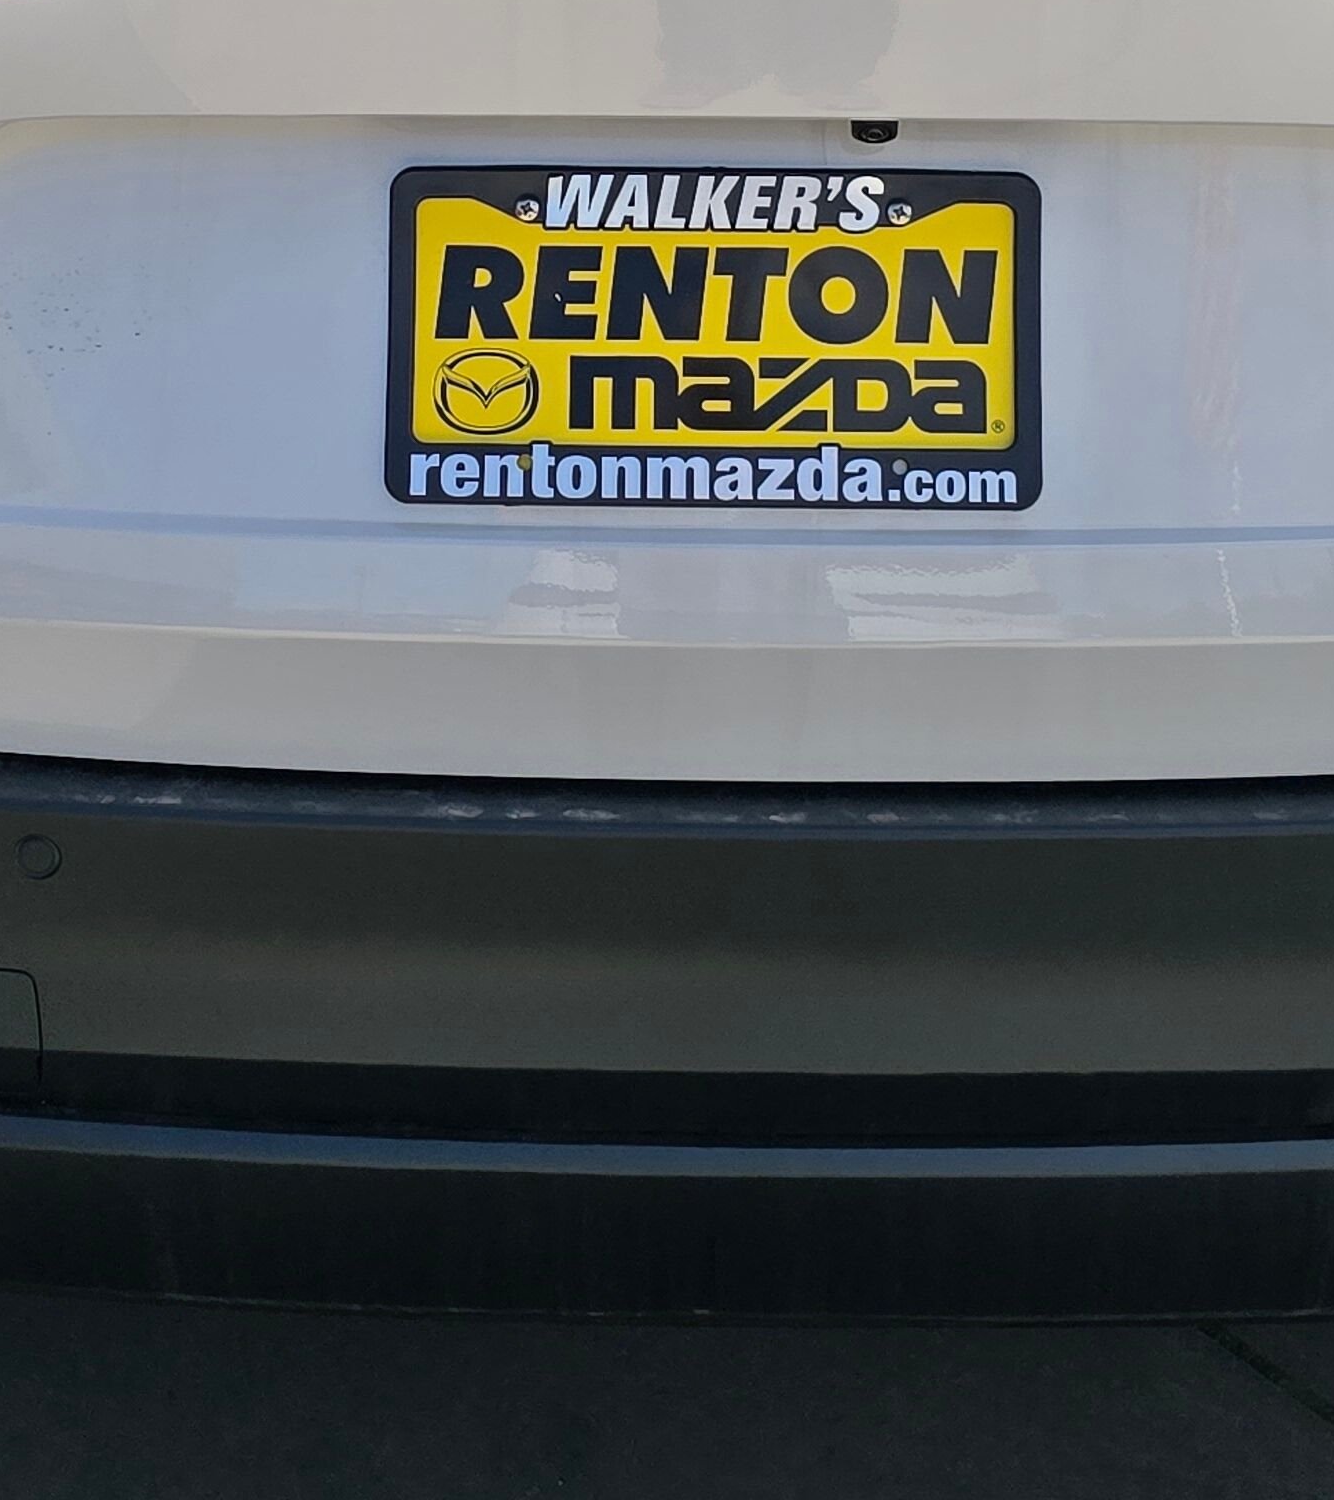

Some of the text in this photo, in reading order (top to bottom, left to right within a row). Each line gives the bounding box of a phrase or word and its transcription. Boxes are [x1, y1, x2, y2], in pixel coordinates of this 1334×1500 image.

[544, 173, 886, 234] WALKER'S
[433, 243, 1000, 345] RENTON
[408, 442, 1019, 504] rentonmazda.com
